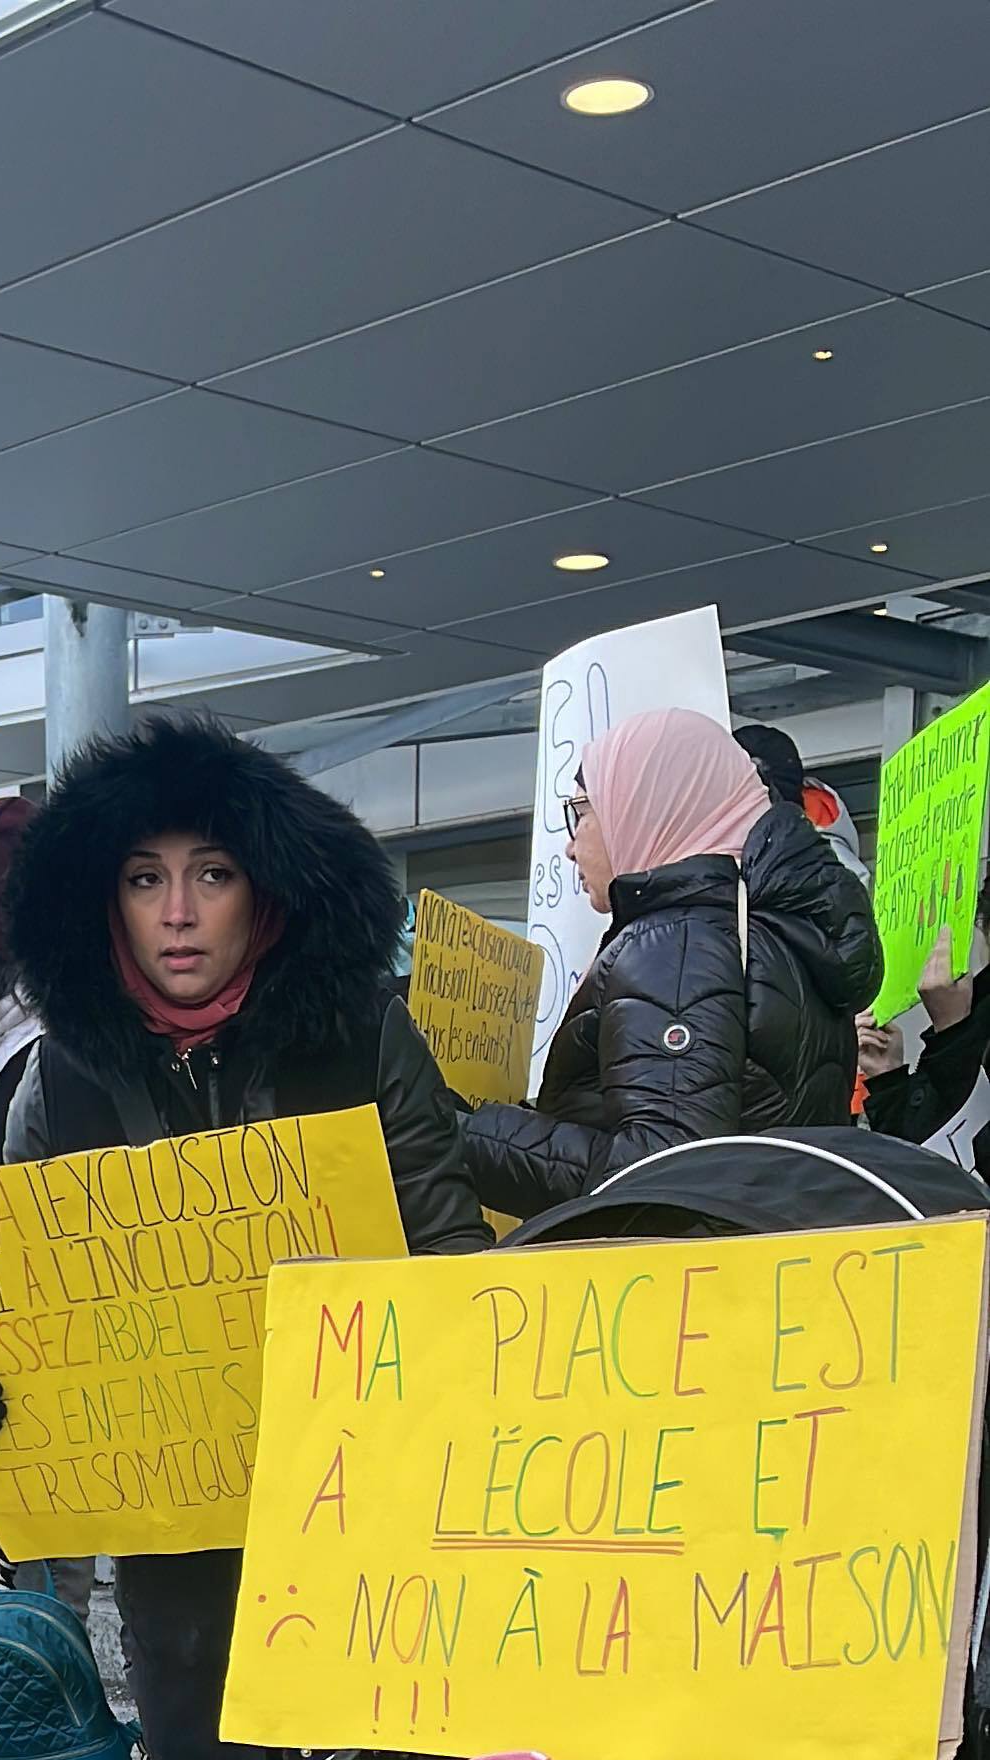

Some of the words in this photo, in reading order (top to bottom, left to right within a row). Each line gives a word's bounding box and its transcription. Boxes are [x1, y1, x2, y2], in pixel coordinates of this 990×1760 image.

[889, 870, 918, 932] AMIS
[446, 1008, 463, 1063] les
[23, 1242, 51, 1309] À
[93, 1297, 209, 1363] ABDEL
[216, 1286, 264, 1350] ET
[311, 1299, 404, 1402] MA
[471, 1265, 720, 1401] PLACE
[771, 1241, 927, 1395] EST
[57, 1361, 258, 1446] ENFANTS
[301, 1428, 358, 1537] À
[753, 1406, 849, 1542] ET
[346, 1572, 467, 1668] NON
[496, 1567, 543, 1669] À
[575, 1575, 633, 1678] LA
[692, 1536, 960, 1675] MAISON
